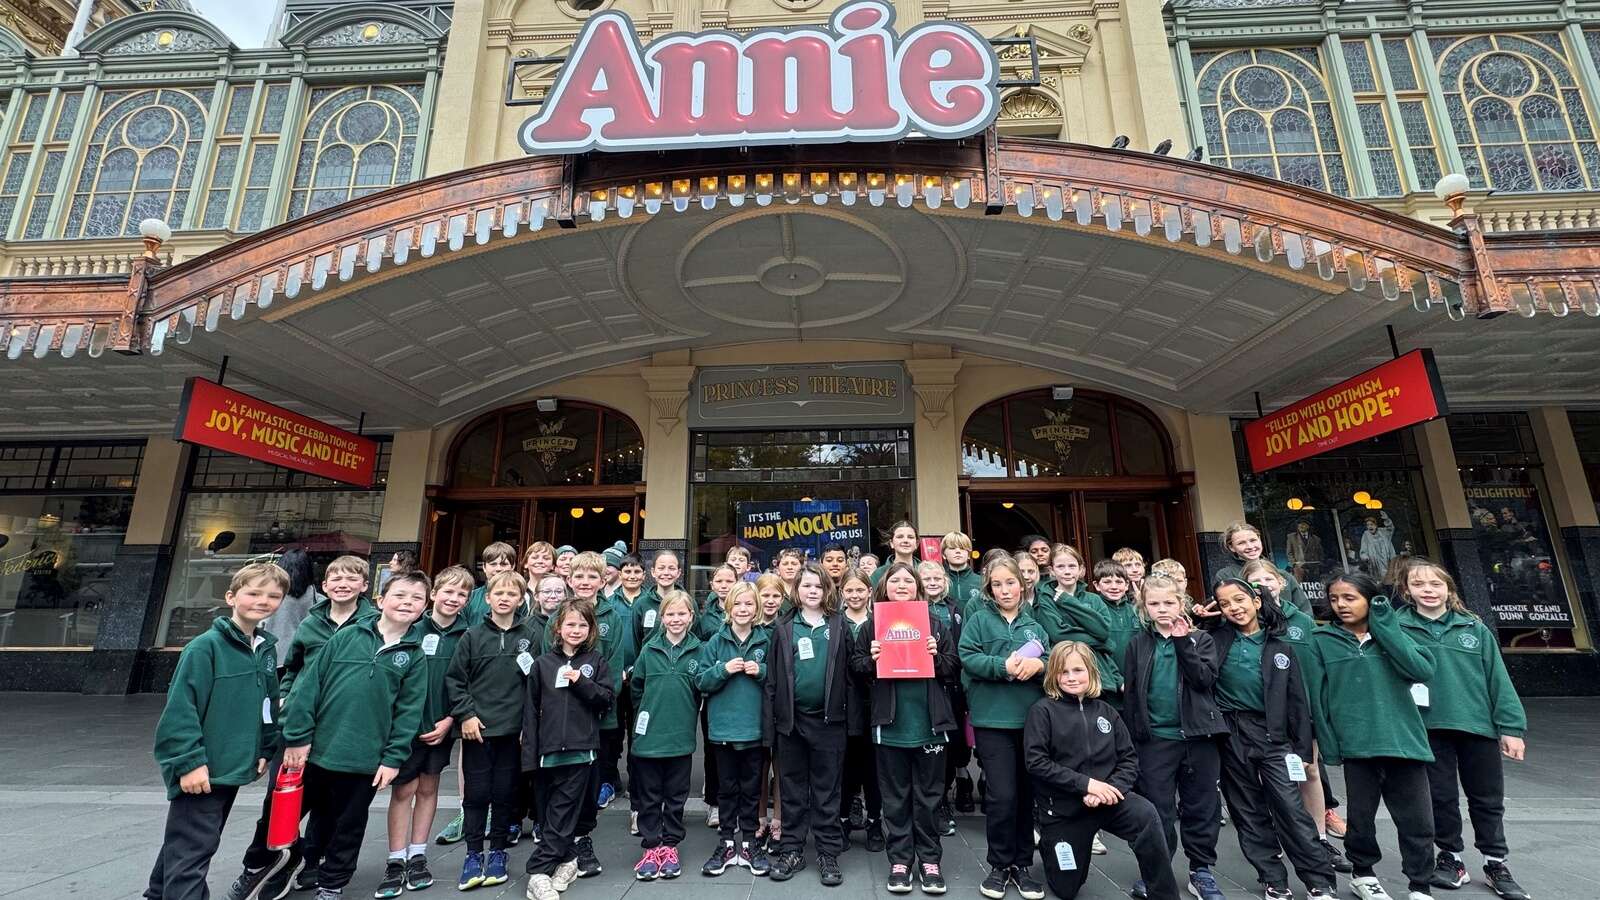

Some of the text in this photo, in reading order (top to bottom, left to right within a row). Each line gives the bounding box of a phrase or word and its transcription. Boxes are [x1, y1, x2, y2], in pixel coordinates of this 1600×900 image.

[524, 2, 992, 148] Annie
[703, 375, 897, 403] PRINCESS THEATRE
[1264, 376, 1383, 433] “FILLED WITH OPTIMISM
[225, 399, 358, 452] “A FANTASTIC CELEBRATION OF
[1265, 386, 1400, 457] JOY AND HOPE”
[204, 409, 365, 471] JOY, MUSIC AND LIFE”
[743, 512, 858, 541] HARD KNOCK LIFE
[748, 511, 781, 523] IT'S THE
[830, 528, 863, 540] FOR US!
[1490, 604, 1528, 612] MACKENZIE
[1499, 612, 1524, 621] DUNN
[1528, 613, 1569, 621] GONZALEZ
[1533, 604, 1561, 613] KEANU
[885, 627, 921, 641] Annie
